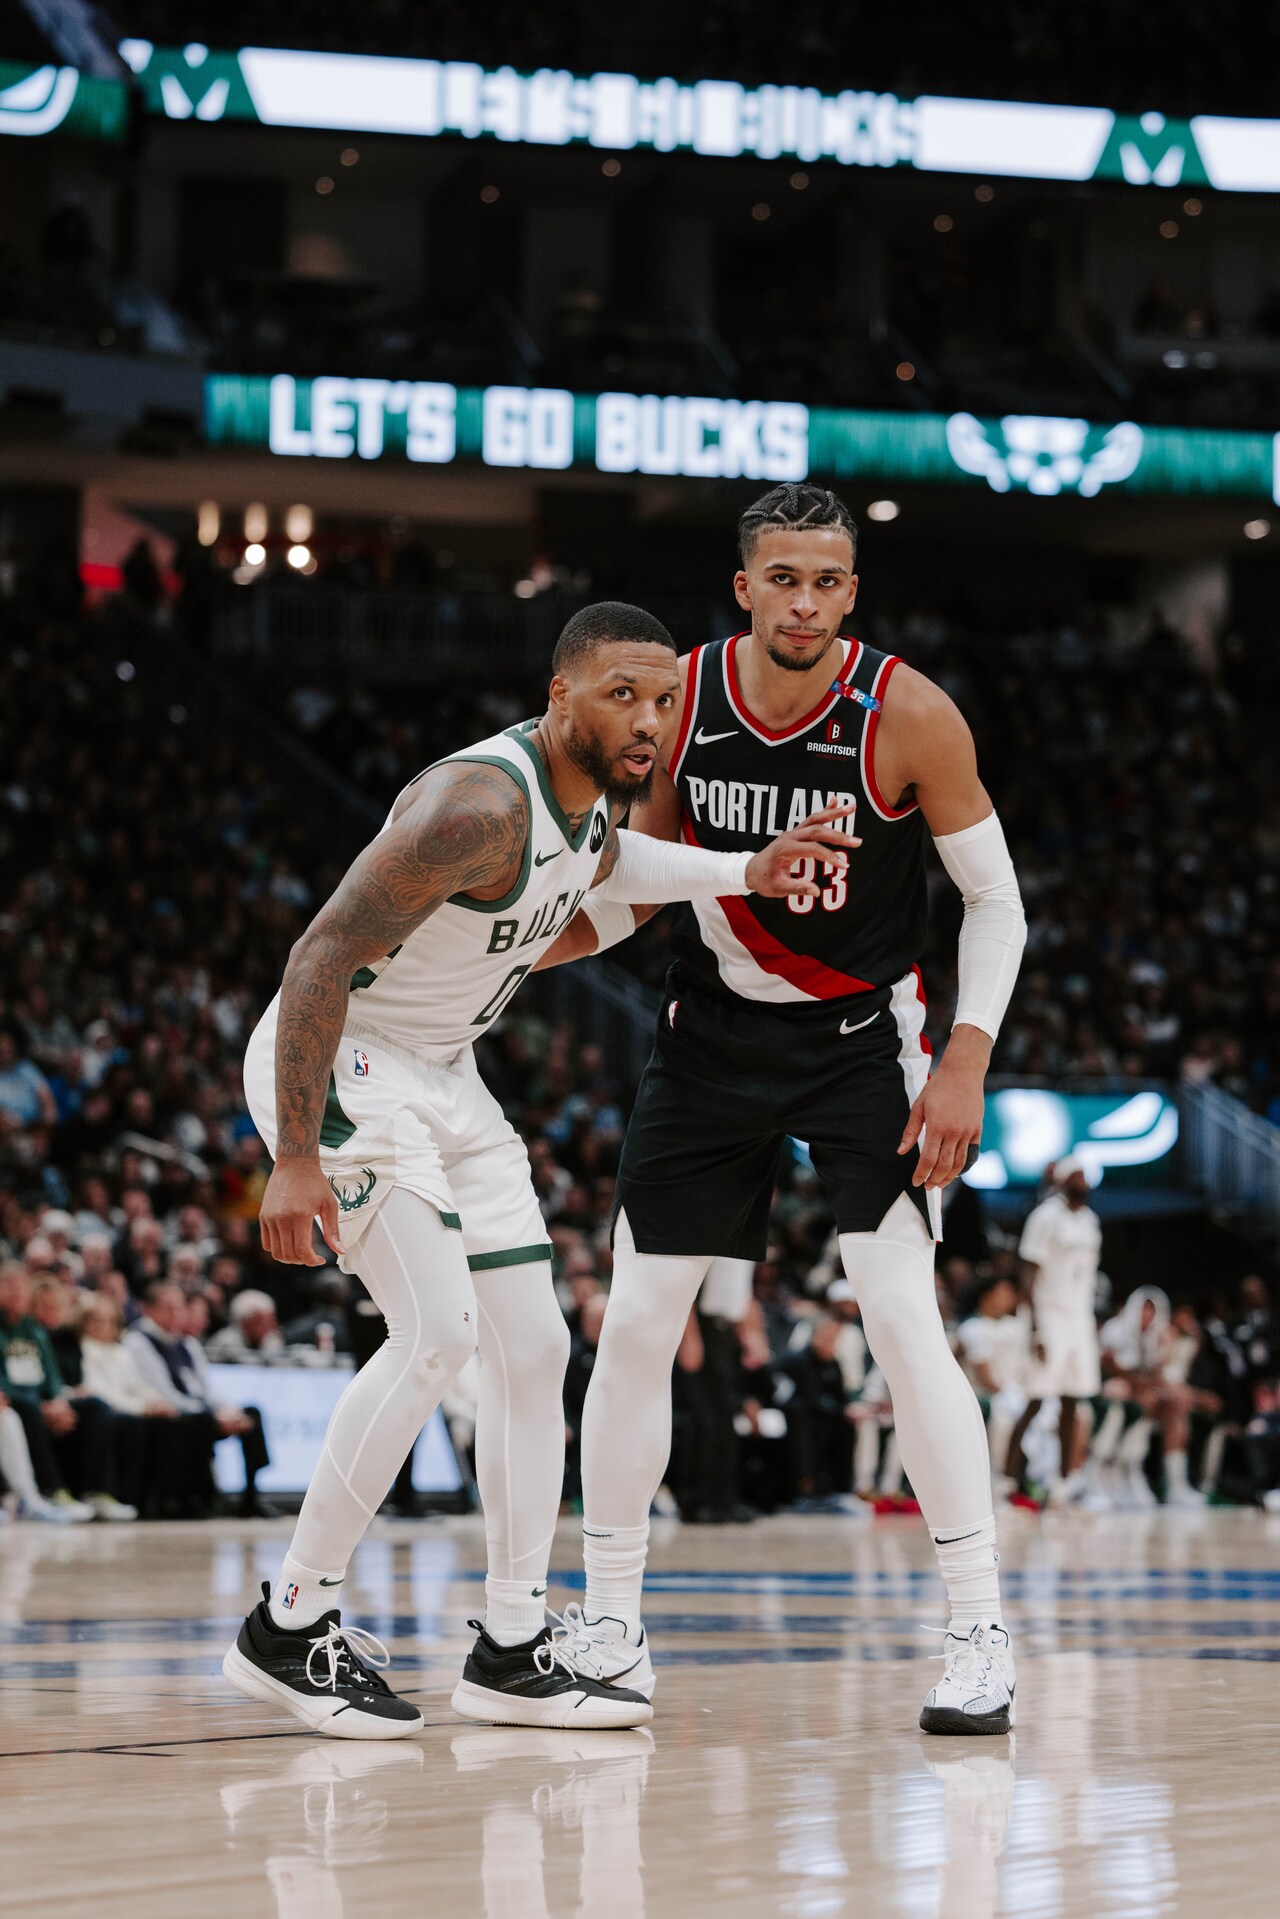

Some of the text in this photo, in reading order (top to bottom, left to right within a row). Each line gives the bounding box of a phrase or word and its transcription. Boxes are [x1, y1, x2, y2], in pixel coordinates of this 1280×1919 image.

[269, 373, 810, 482] LET'S GO BUCKS
[850, 688, 866, 704] 32
[806, 742, 857, 757] BRIGHTSIDE
[786, 850, 849, 915] 33
[470, 963, 533, 1026] 0
